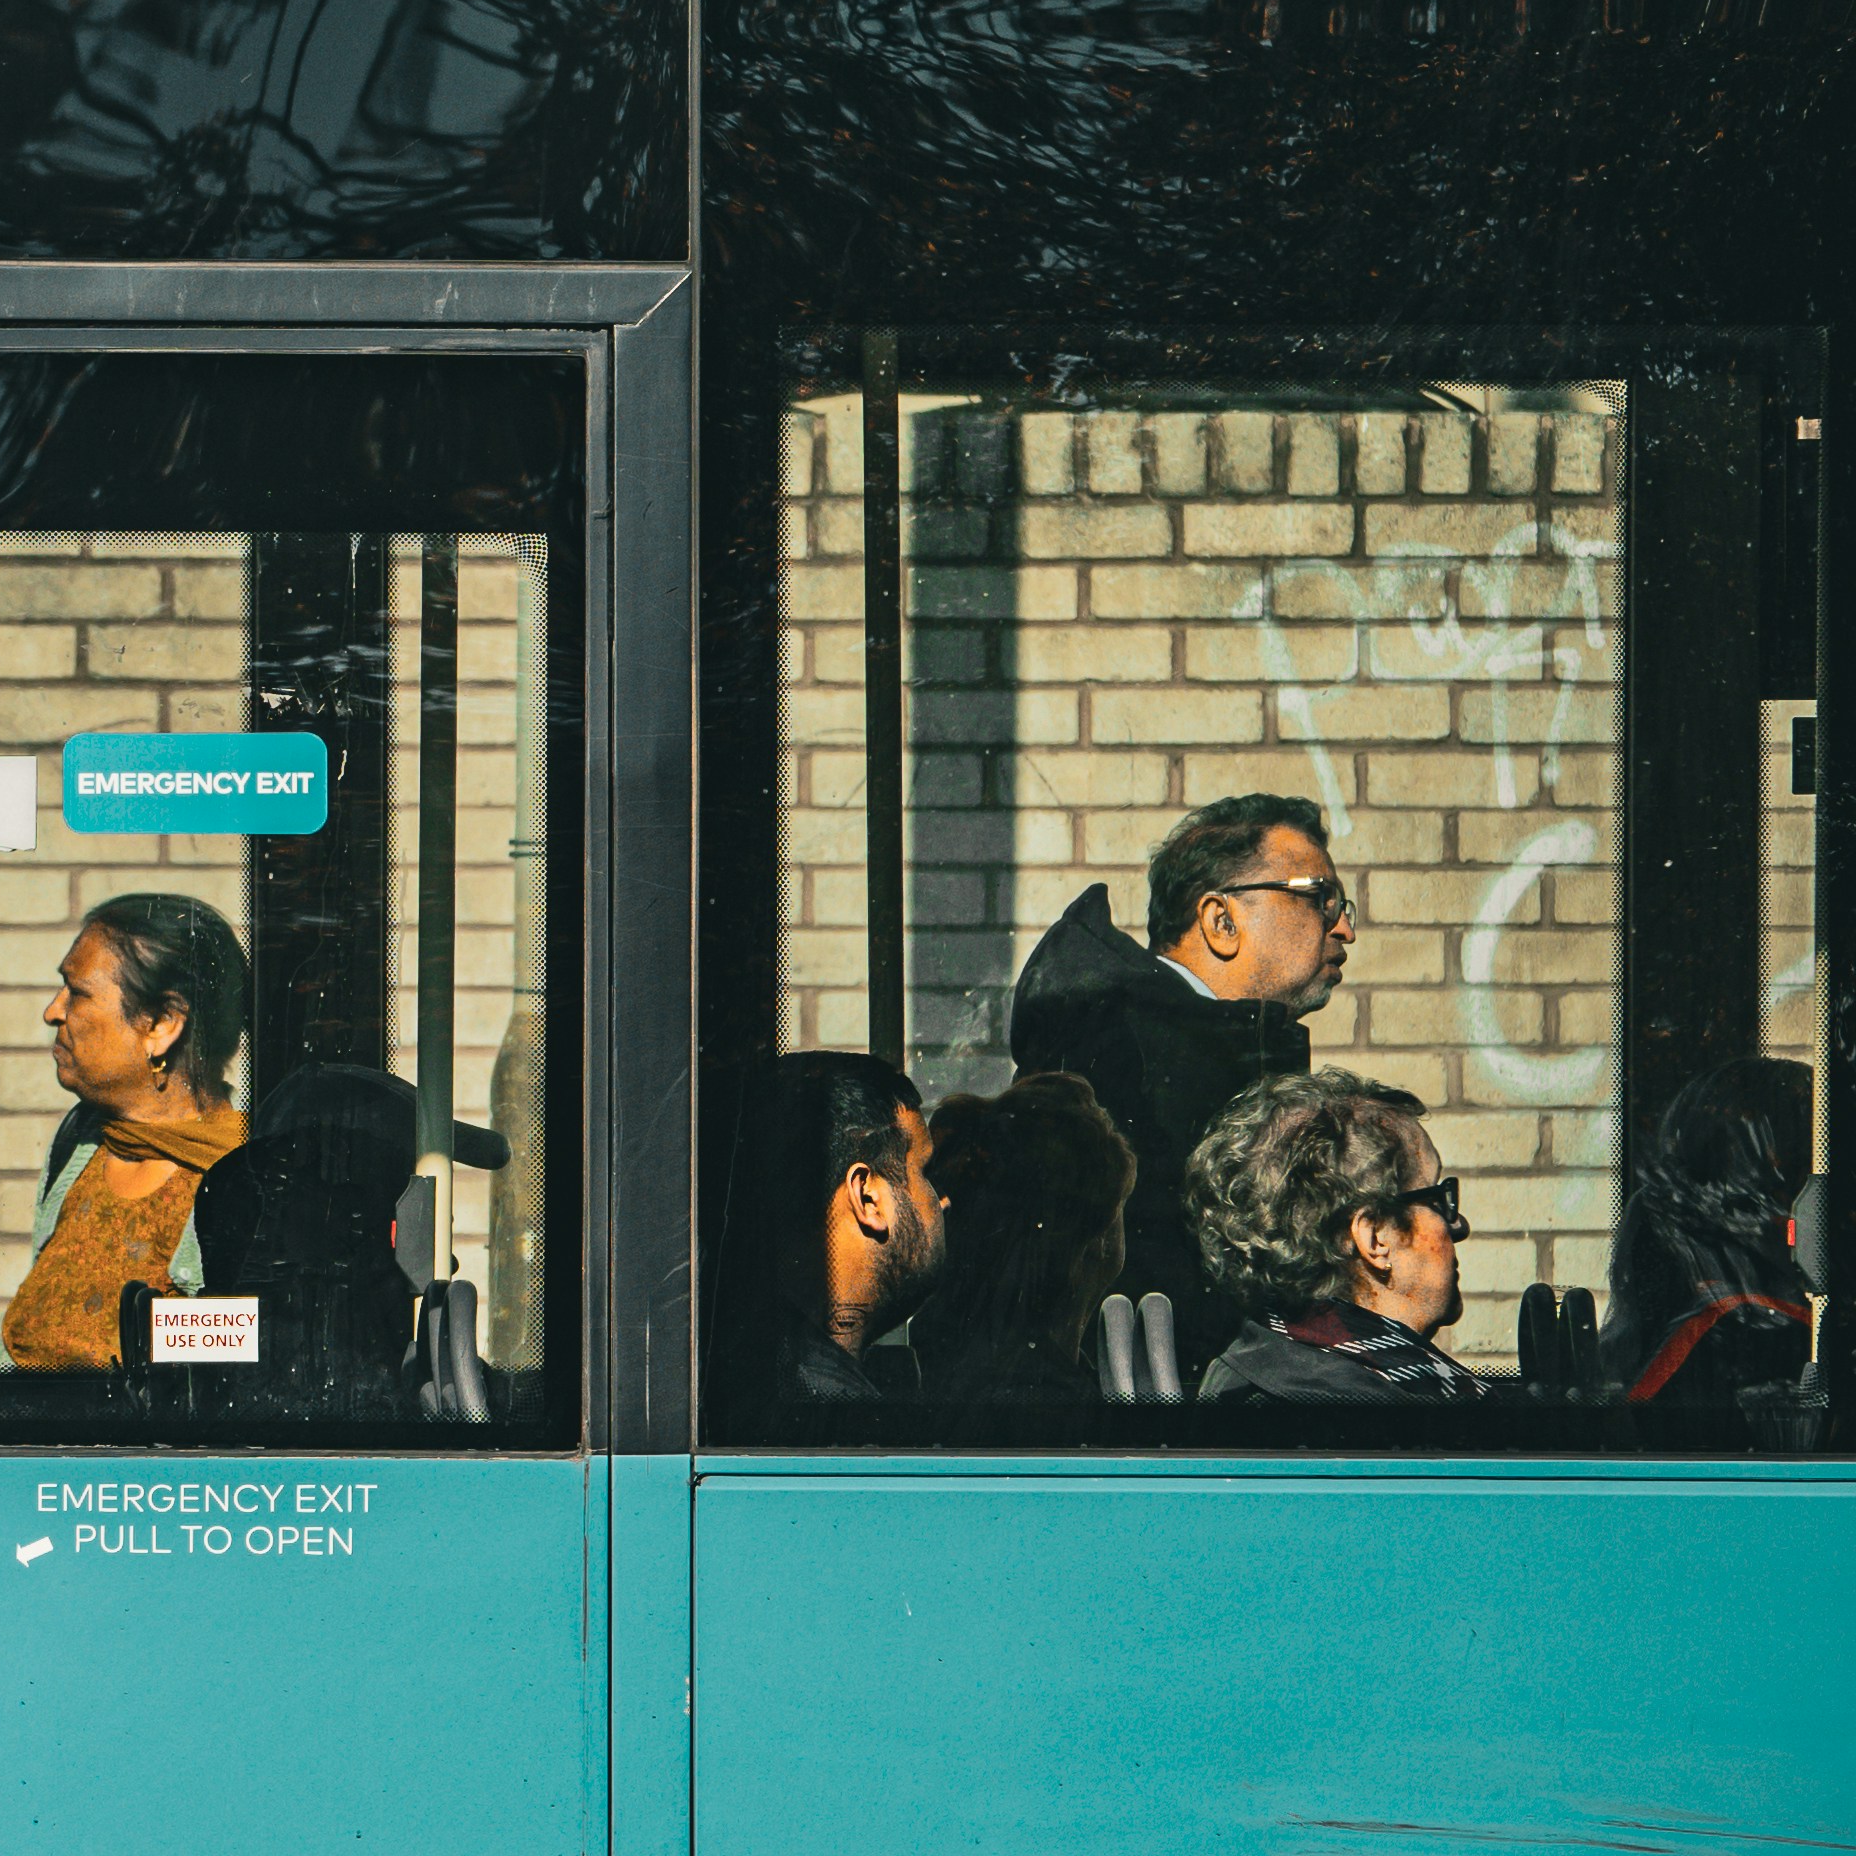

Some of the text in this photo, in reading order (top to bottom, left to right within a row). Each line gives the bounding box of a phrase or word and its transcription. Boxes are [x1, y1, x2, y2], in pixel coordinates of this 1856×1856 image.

[78, 772, 314, 794] EMERGENCY EXIT
[155, 1314, 256, 1327] EMERGENCY
[166, 1334, 246, 1347] USE ONLY
[38, 1484, 378, 1513] EMERGENCY EXIT
[75, 1525, 353, 1556] PULL TO OPEN
